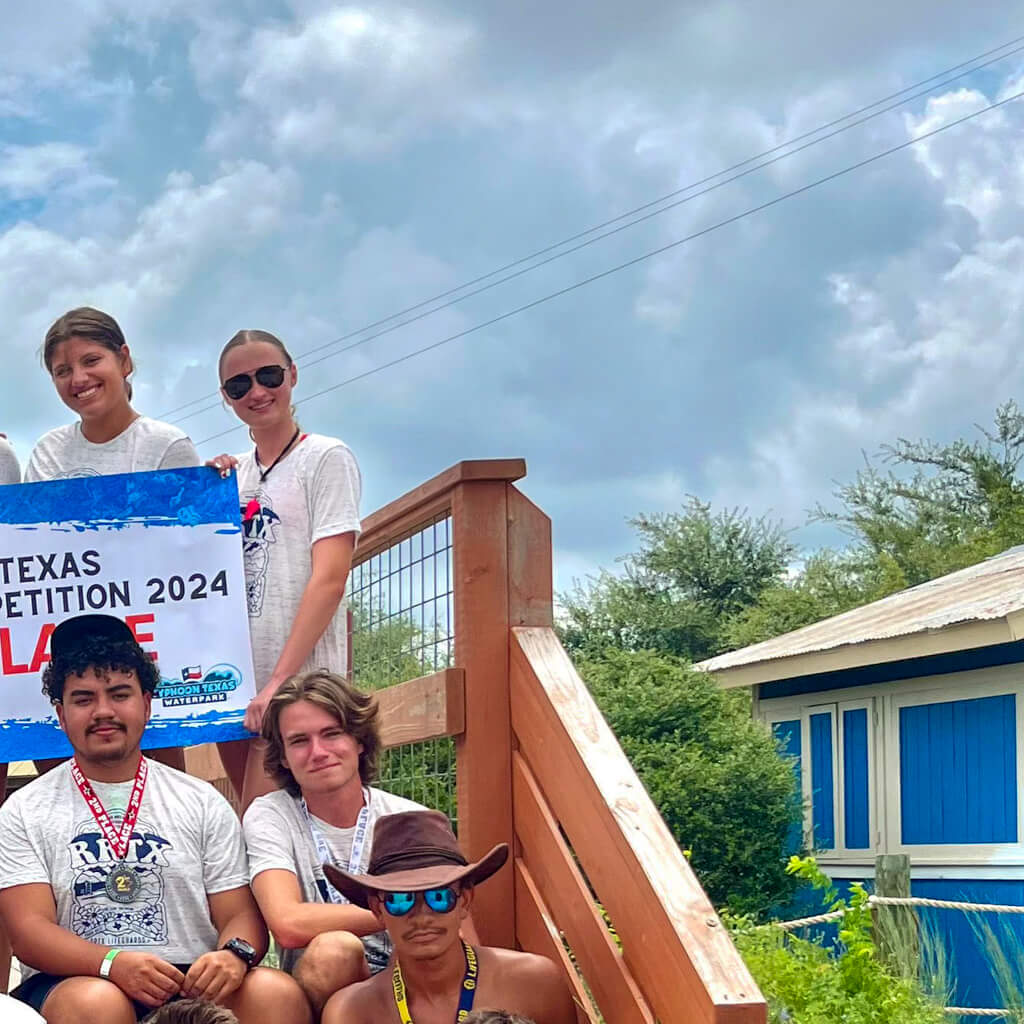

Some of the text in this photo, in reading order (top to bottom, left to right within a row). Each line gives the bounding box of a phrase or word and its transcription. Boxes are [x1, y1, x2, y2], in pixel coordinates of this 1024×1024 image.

[146, 570, 228, 605] 2024
[202, 680, 236, 693] TEXAS
[164, 693, 225, 706] WATERPARK
[131, 790, 141, 808] 2ND
[88, 797, 103, 814] 2ND
[98, 814, 120, 846] PLACE
